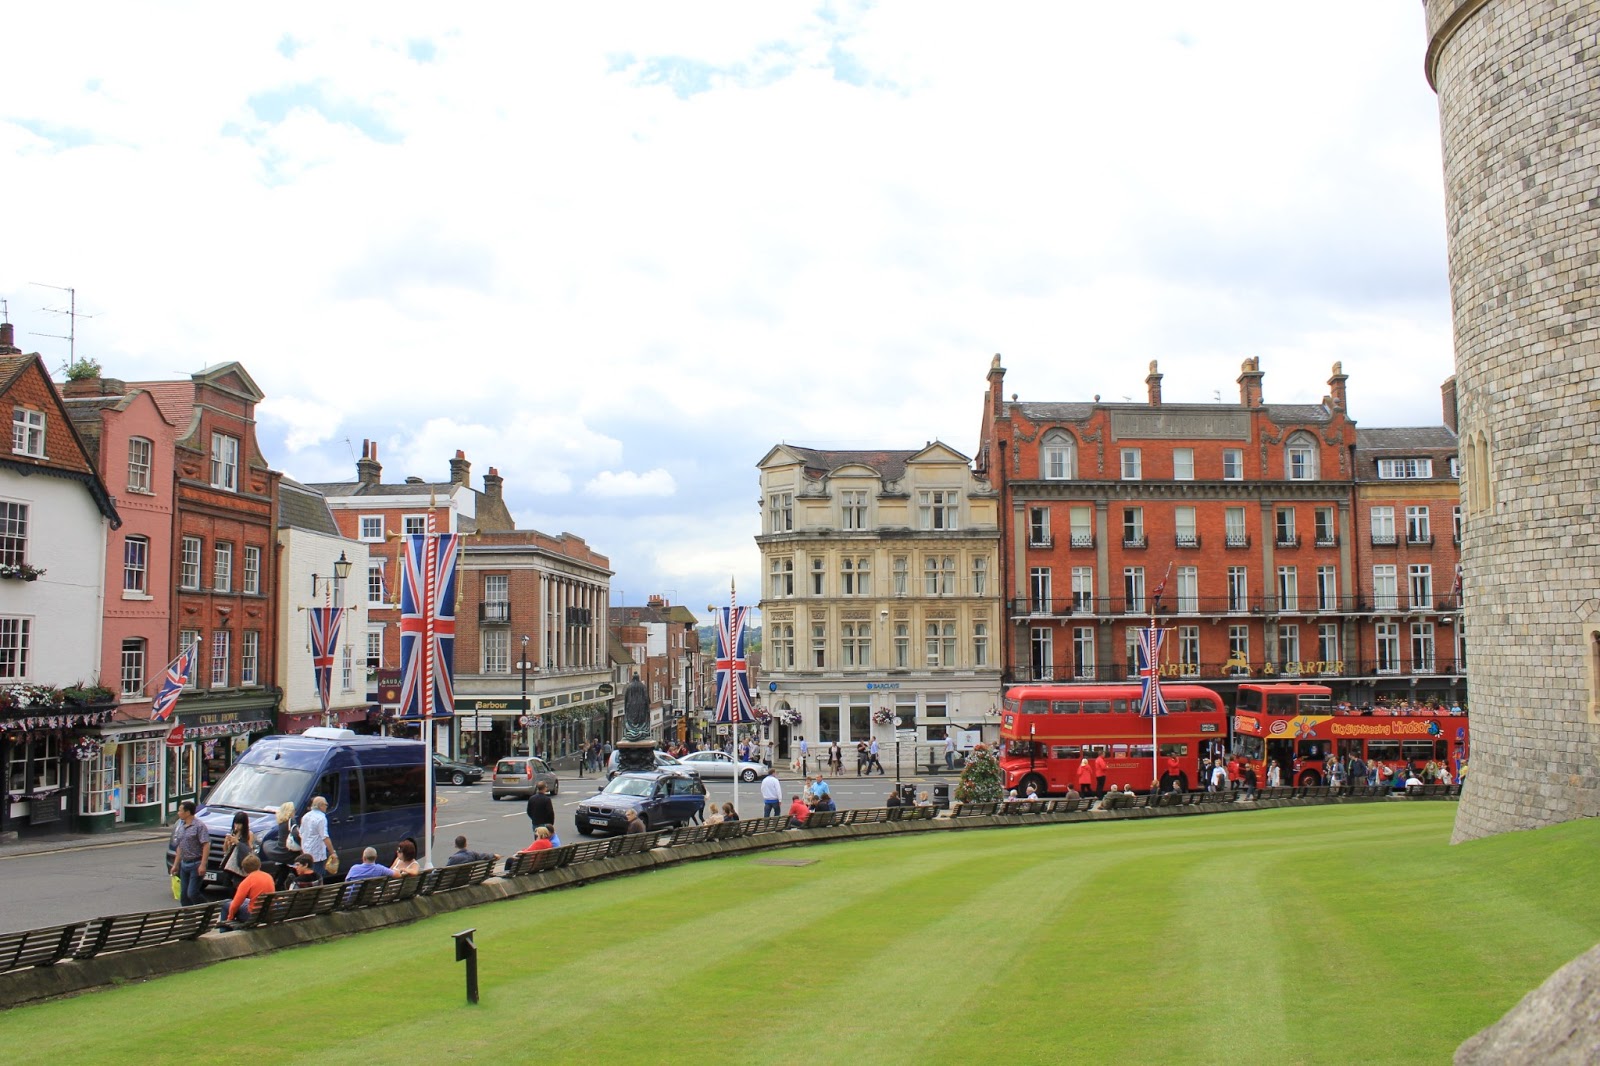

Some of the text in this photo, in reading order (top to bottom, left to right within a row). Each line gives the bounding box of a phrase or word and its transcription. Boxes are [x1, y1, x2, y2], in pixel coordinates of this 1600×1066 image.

[1204, 417, 1246, 434] HOTEL
[1158, 660, 1344, 676] ARTE & GARTER
[476, 701, 508, 709] Barbour
[199, 713, 239, 724] CYRIL HOWE
[1391, 720, 1432, 734] Windsor
